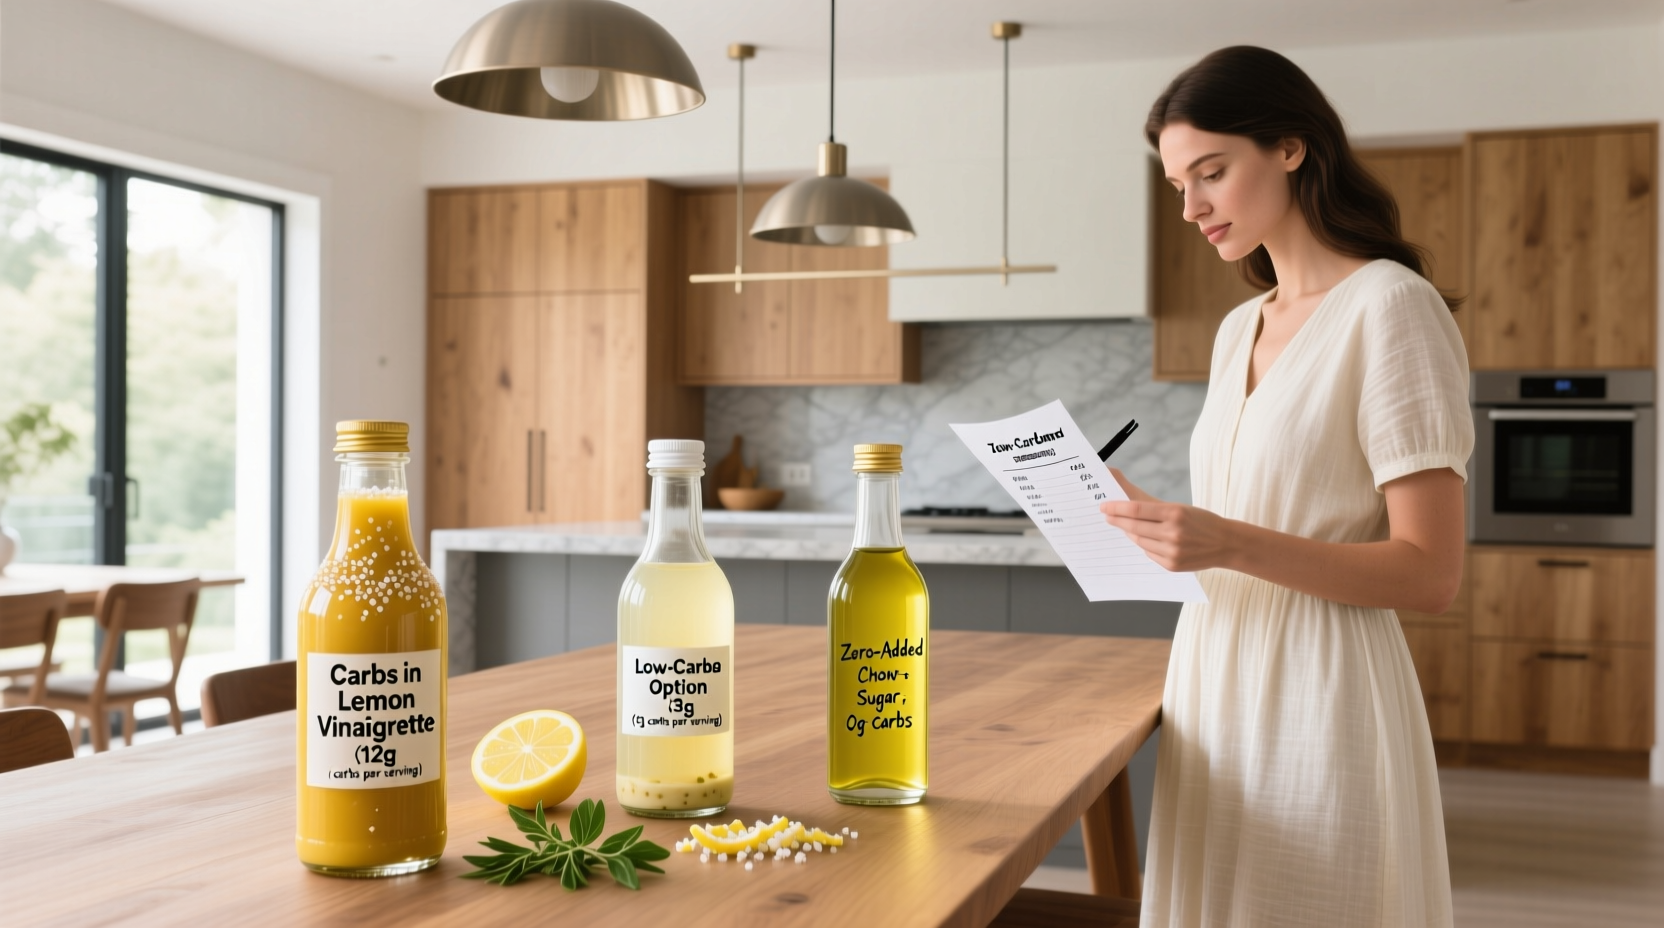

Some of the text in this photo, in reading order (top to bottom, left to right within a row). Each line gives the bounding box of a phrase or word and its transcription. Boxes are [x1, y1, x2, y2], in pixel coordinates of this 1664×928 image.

[840, 637, 923, 662] Zero-Added
[330, 661, 422, 686] Carbs in
[649, 678, 708, 700] Option
[338, 690, 416, 712] Lemon
[317, 713, 436, 743] Vinaigrette
[871, 710, 913, 730] carbs
[354, 744, 397, 767] (12g
